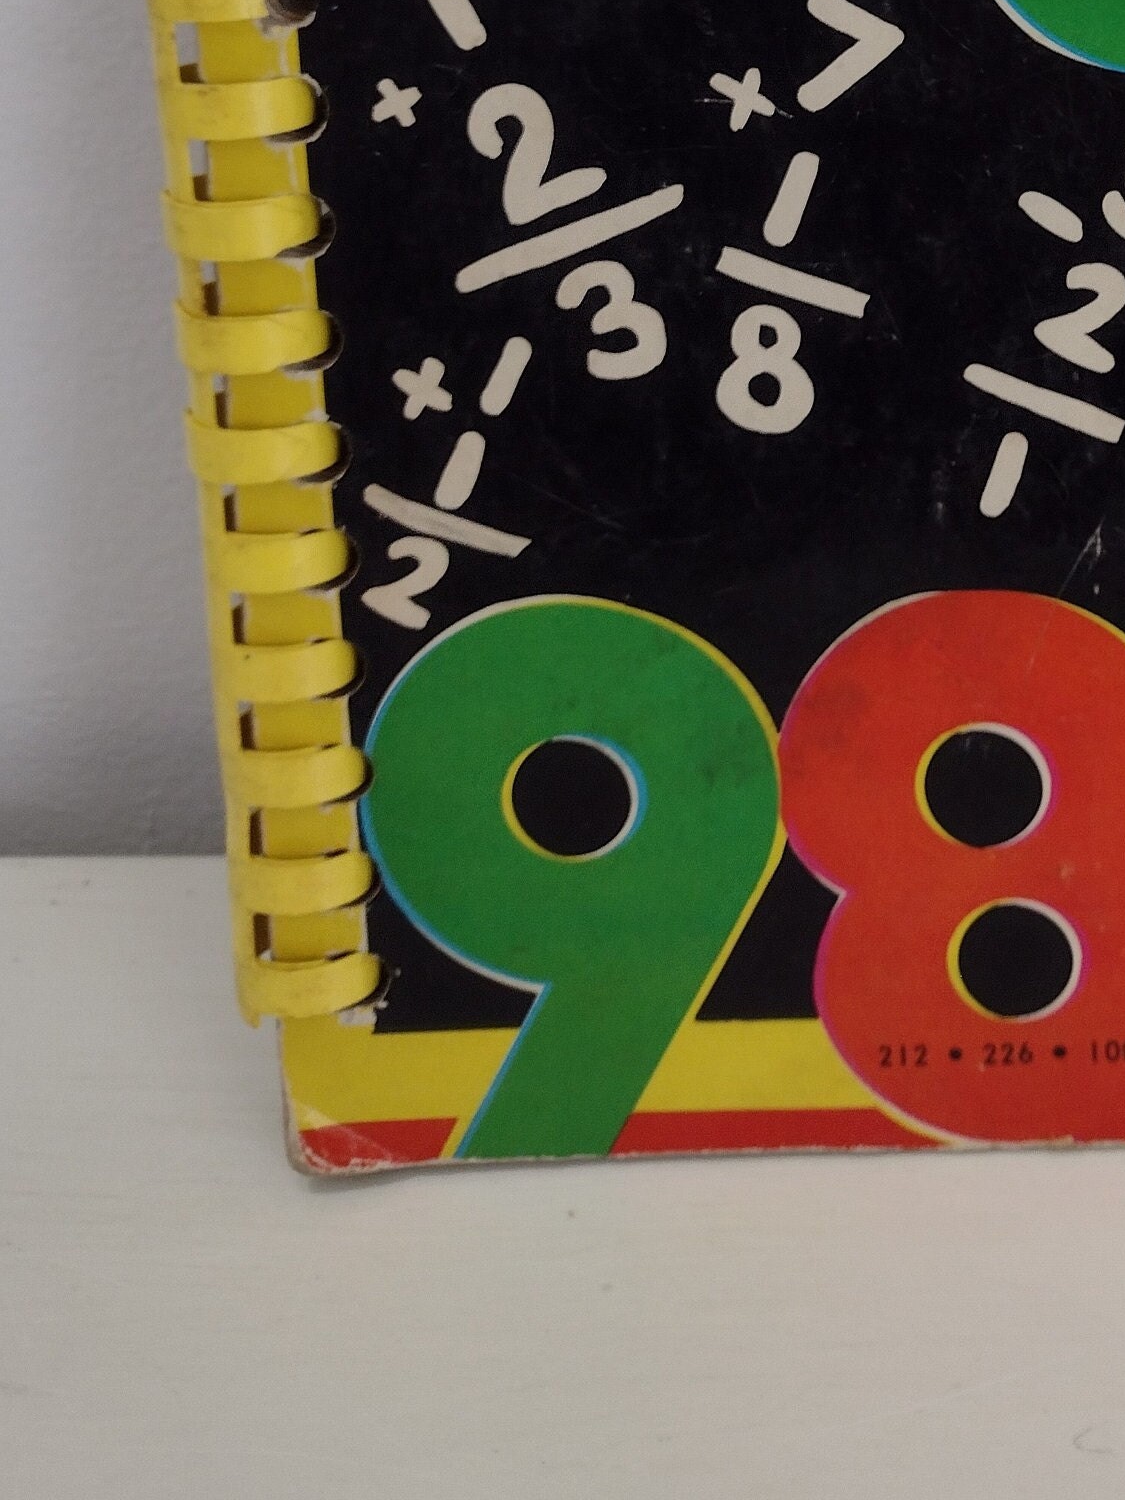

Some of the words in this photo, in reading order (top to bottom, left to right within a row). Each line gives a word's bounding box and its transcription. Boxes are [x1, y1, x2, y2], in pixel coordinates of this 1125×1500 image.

[467, 82, 608, 225] 2
[555, 260, 668, 381] 3
[716, 304, 816, 435] 8
[361, 536, 450, 630] 2
[359, 594, 788, 1159] 9
[879, 1044, 930, 1068] 212
[983, 1043, 1034, 1065] 226
